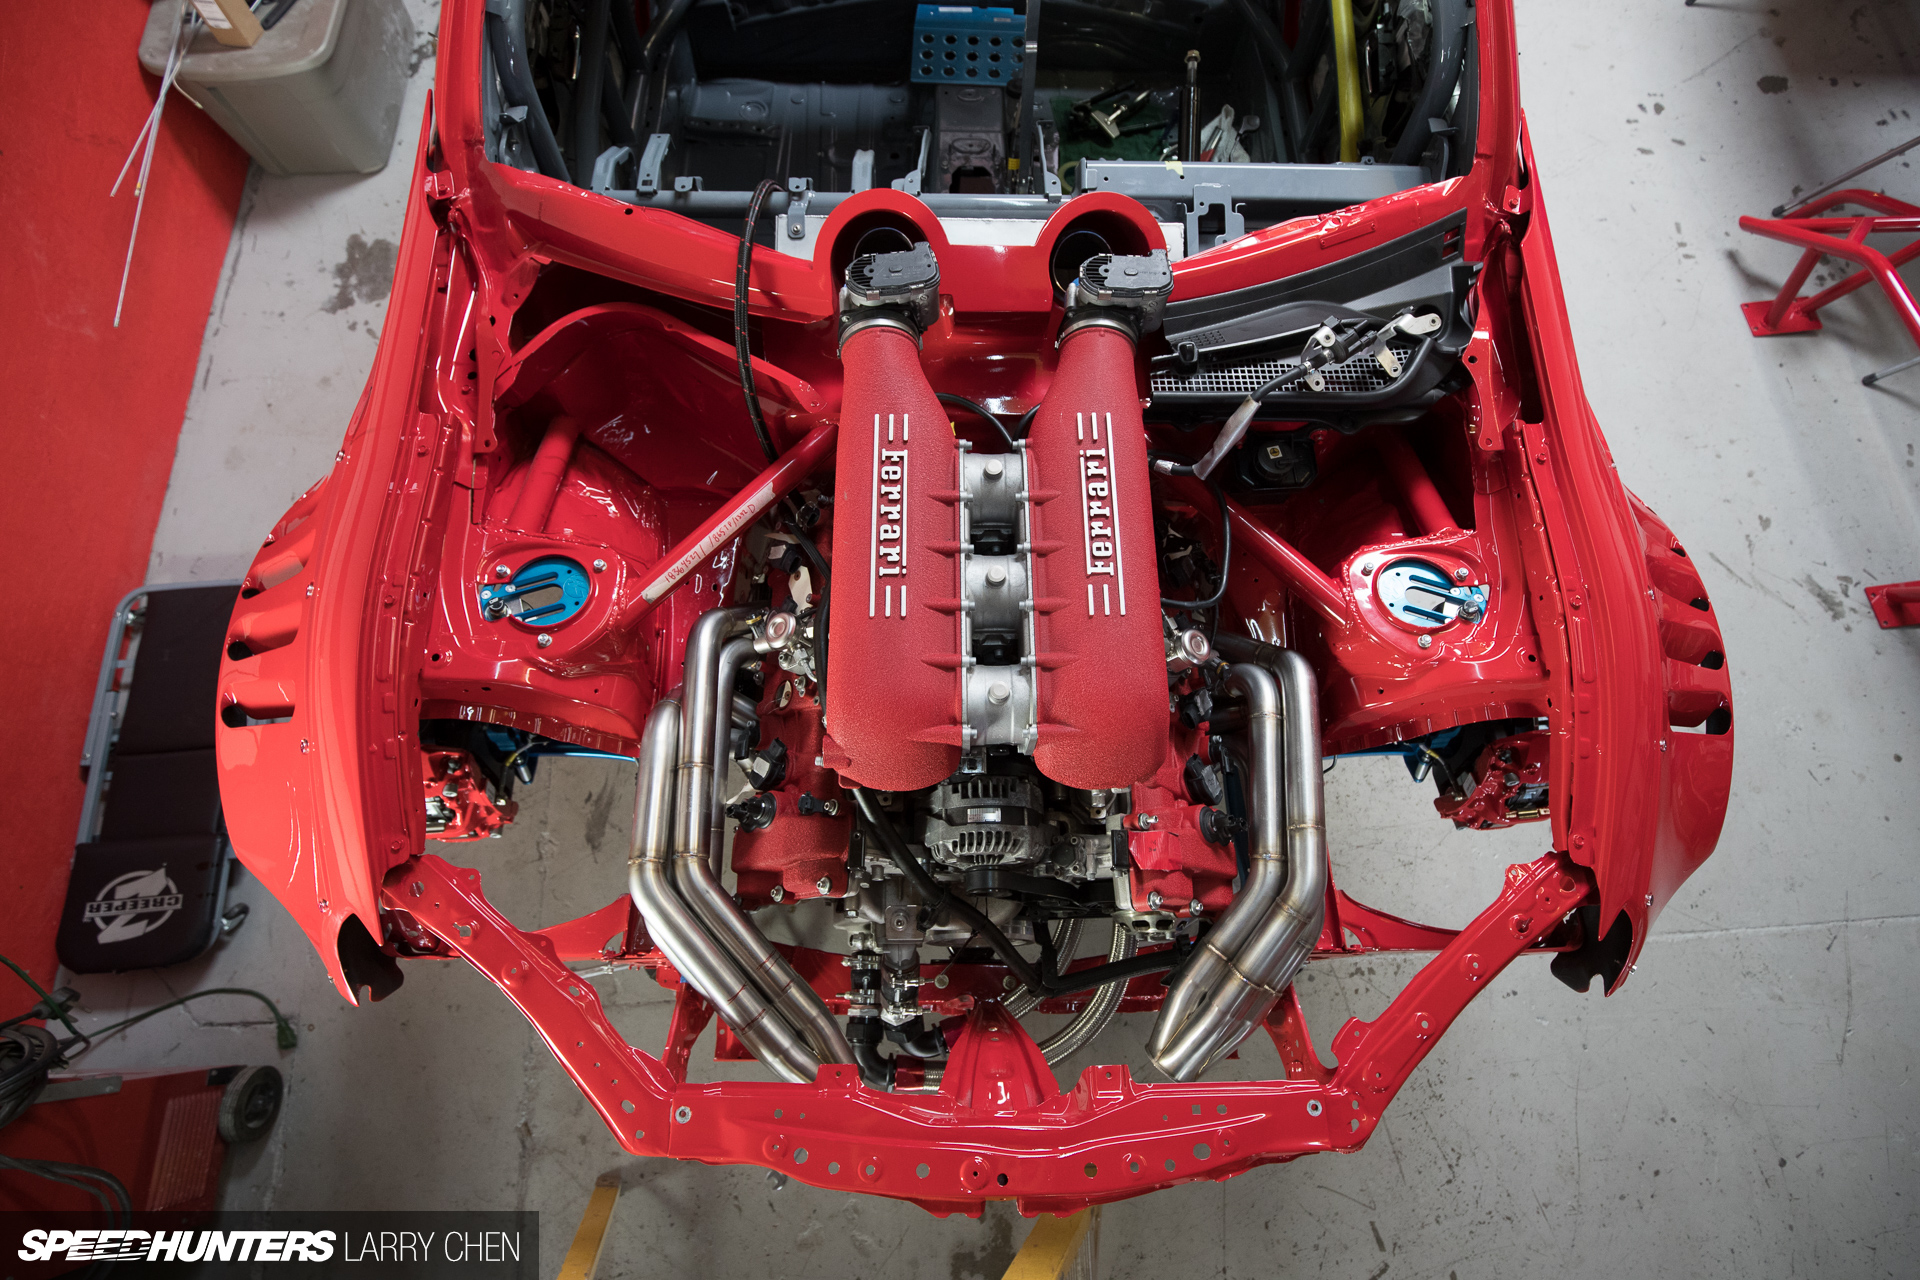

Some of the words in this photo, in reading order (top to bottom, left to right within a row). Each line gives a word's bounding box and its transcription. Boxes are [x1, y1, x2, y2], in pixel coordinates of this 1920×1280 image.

[879, 448, 908, 577] Ferrari
[1079, 447, 1115, 576] Ferrari
[88, 895, 180, 914] CREEPER
